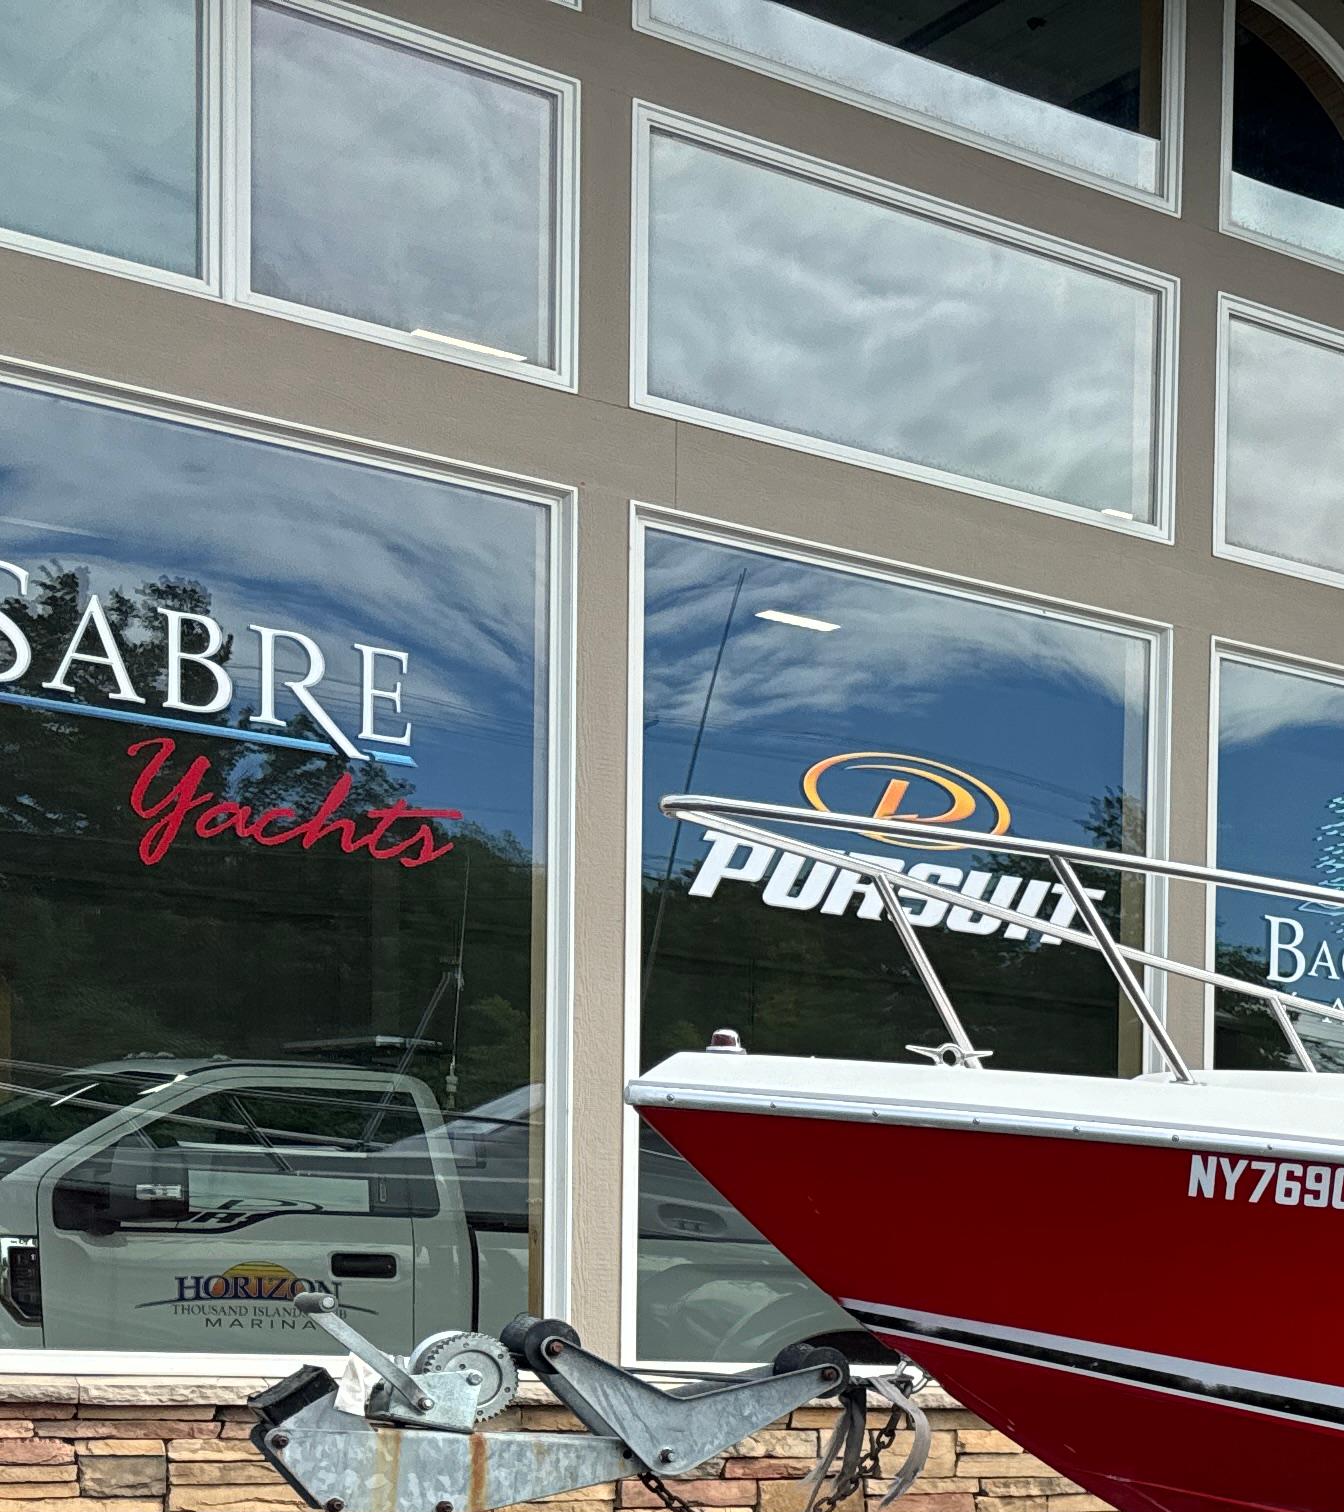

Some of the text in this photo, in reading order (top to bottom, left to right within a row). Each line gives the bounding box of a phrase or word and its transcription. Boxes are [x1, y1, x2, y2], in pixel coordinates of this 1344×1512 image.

[127, 737, 464, 867] Yachts
[688, 830, 1106, 946] PURSUIT
[174, 1275, 342, 1301] HORIZON
[172, 1304, 249, 1316] THOUSAND
[205, 1317, 317, 1331] MARINA
